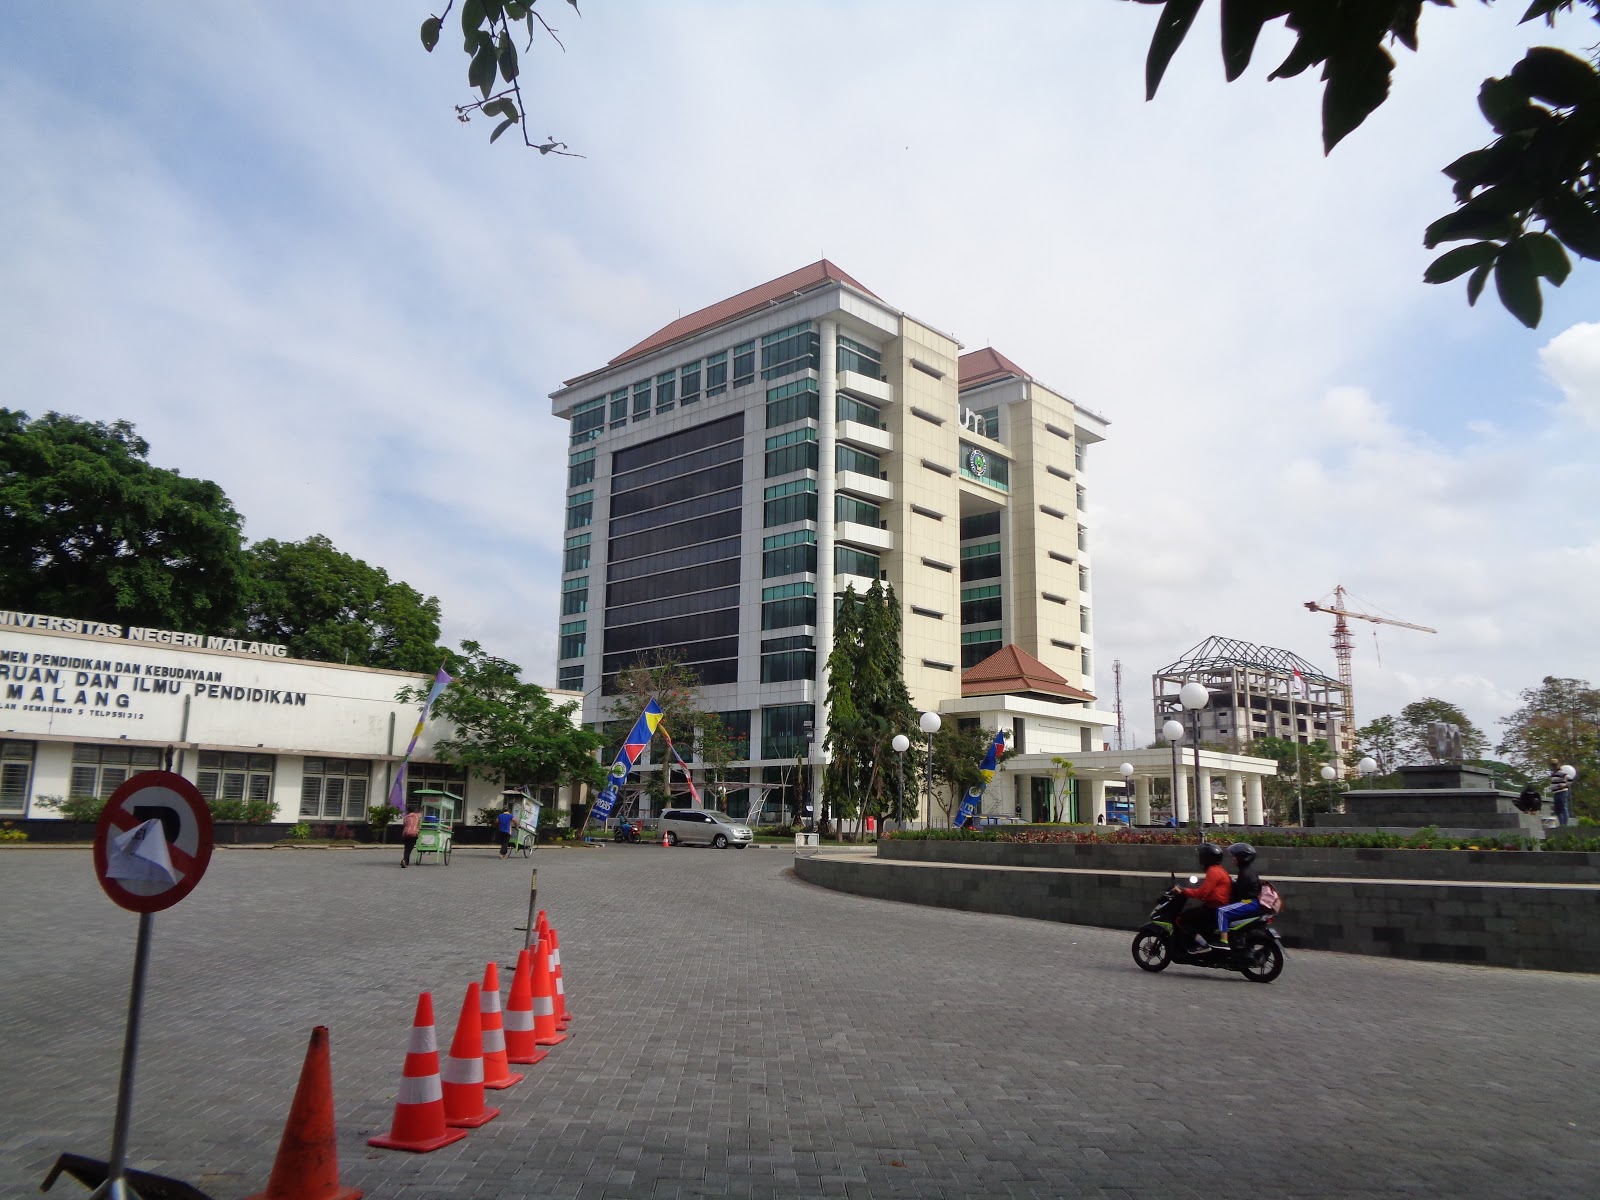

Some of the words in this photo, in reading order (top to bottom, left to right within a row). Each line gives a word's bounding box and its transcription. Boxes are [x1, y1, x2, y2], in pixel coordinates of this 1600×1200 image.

[127, 626, 204, 648] NEGERI
[207, 636, 287, 657] MALANG
[33, 653, 111, 672] PENDIDIKAN
[114, 661, 141, 675] DAN
[145, 664, 222, 682] KEBUDAYAAN
[0, 663, 60, 684] RUAN
[75, 671, 119, 690] DAN
[133, 676, 181, 695] ILMU
[194, 682, 307, 706] PENDIDIKAN
[6, 683, 130, 708] MALANG
[22, 704, 73, 714] SEMARANG
